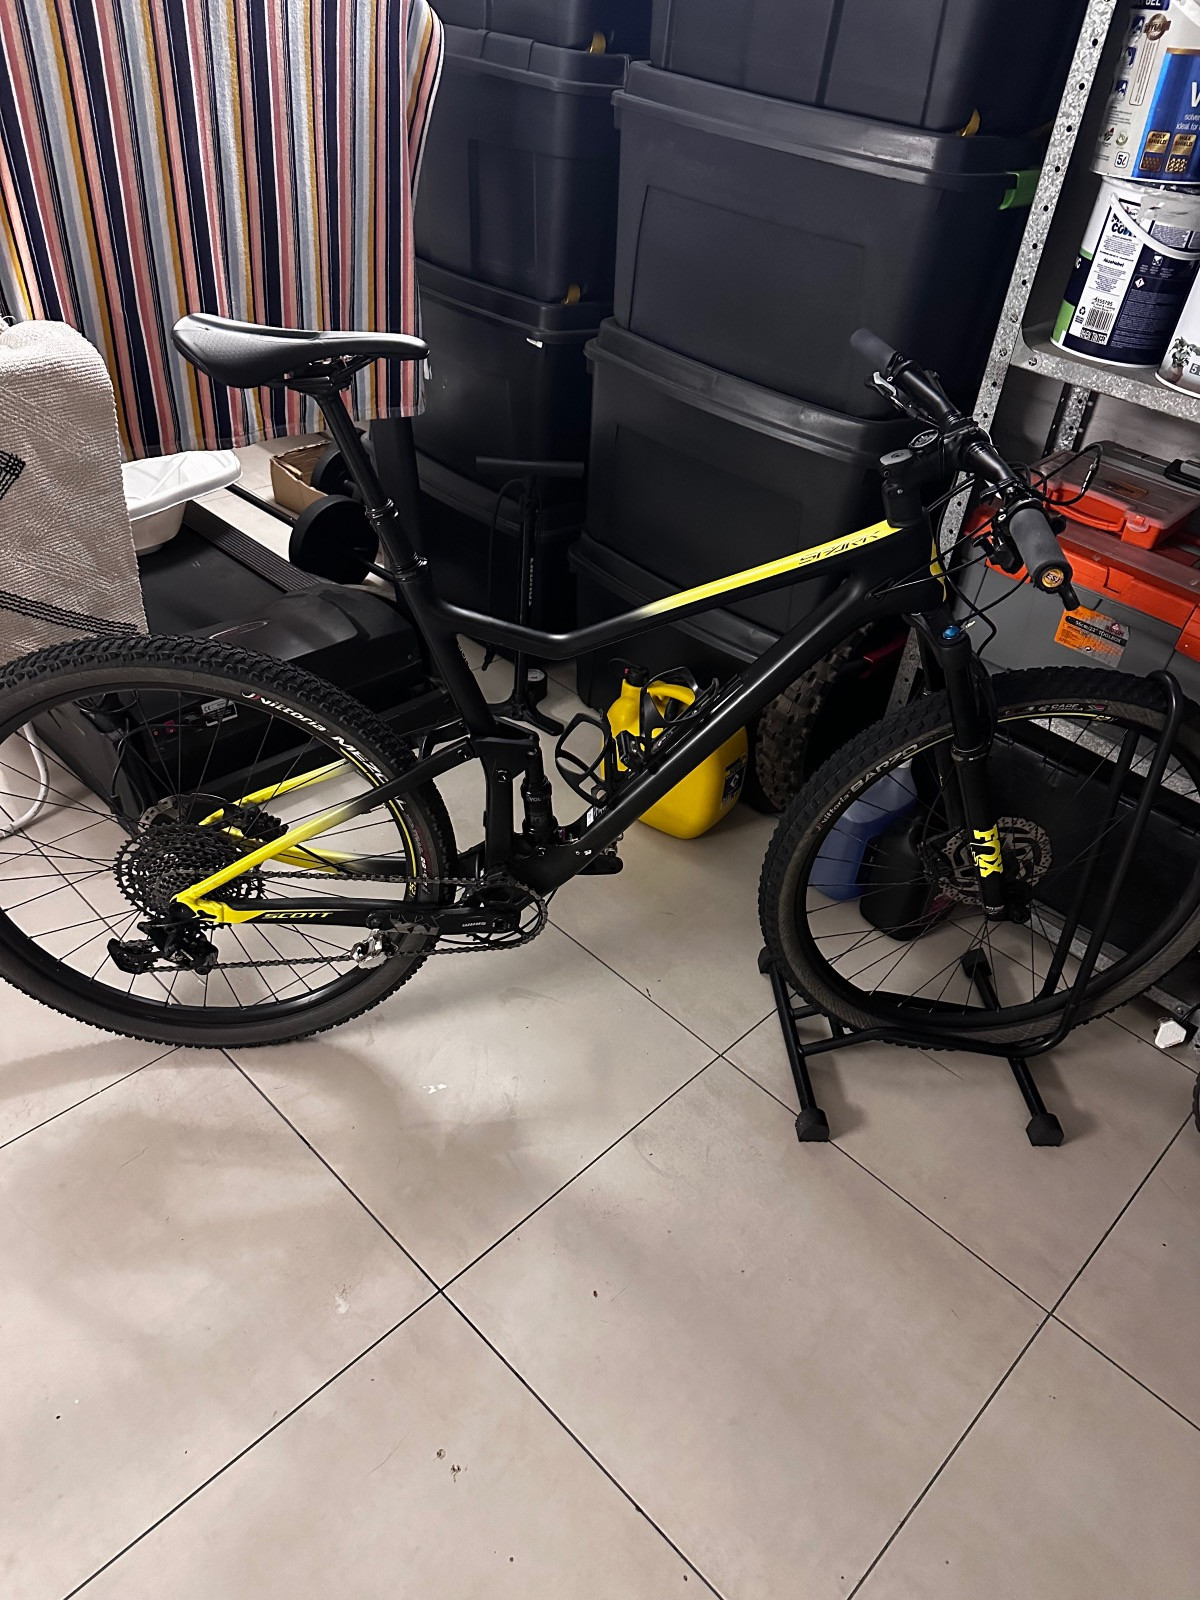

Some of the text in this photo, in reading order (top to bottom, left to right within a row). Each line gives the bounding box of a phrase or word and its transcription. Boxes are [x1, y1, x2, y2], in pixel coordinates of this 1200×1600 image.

[798, 530, 880, 565] SPARK
[850, 743, 918, 793] BARZO
[970, 823, 1004, 878] FOX
[262, 911, 334, 920] SCOTT
